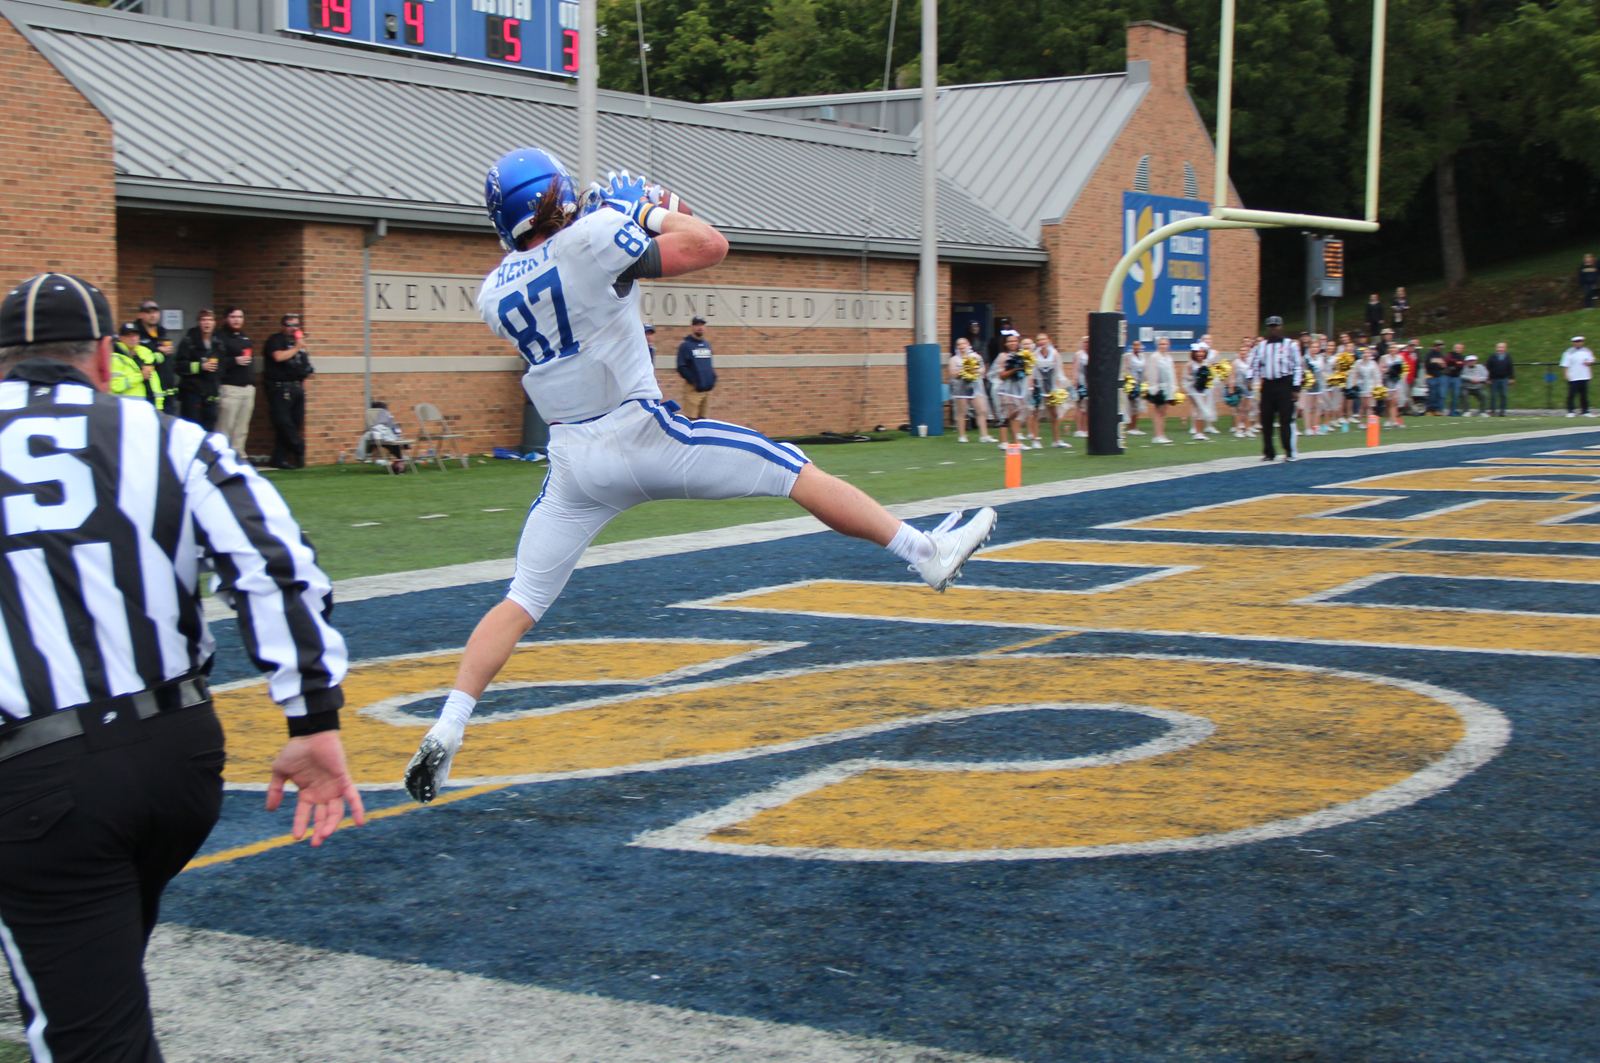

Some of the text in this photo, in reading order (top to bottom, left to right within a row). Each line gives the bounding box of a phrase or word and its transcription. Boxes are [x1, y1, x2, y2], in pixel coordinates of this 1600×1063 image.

[404, 1, 425, 44] 4
[503, 18, 521, 62] 5
[375, 282, 908, 321] KENN OONE FIELD HOUSE
[498, 265, 581, 366] 87
[0, 415, 98, 536] S
